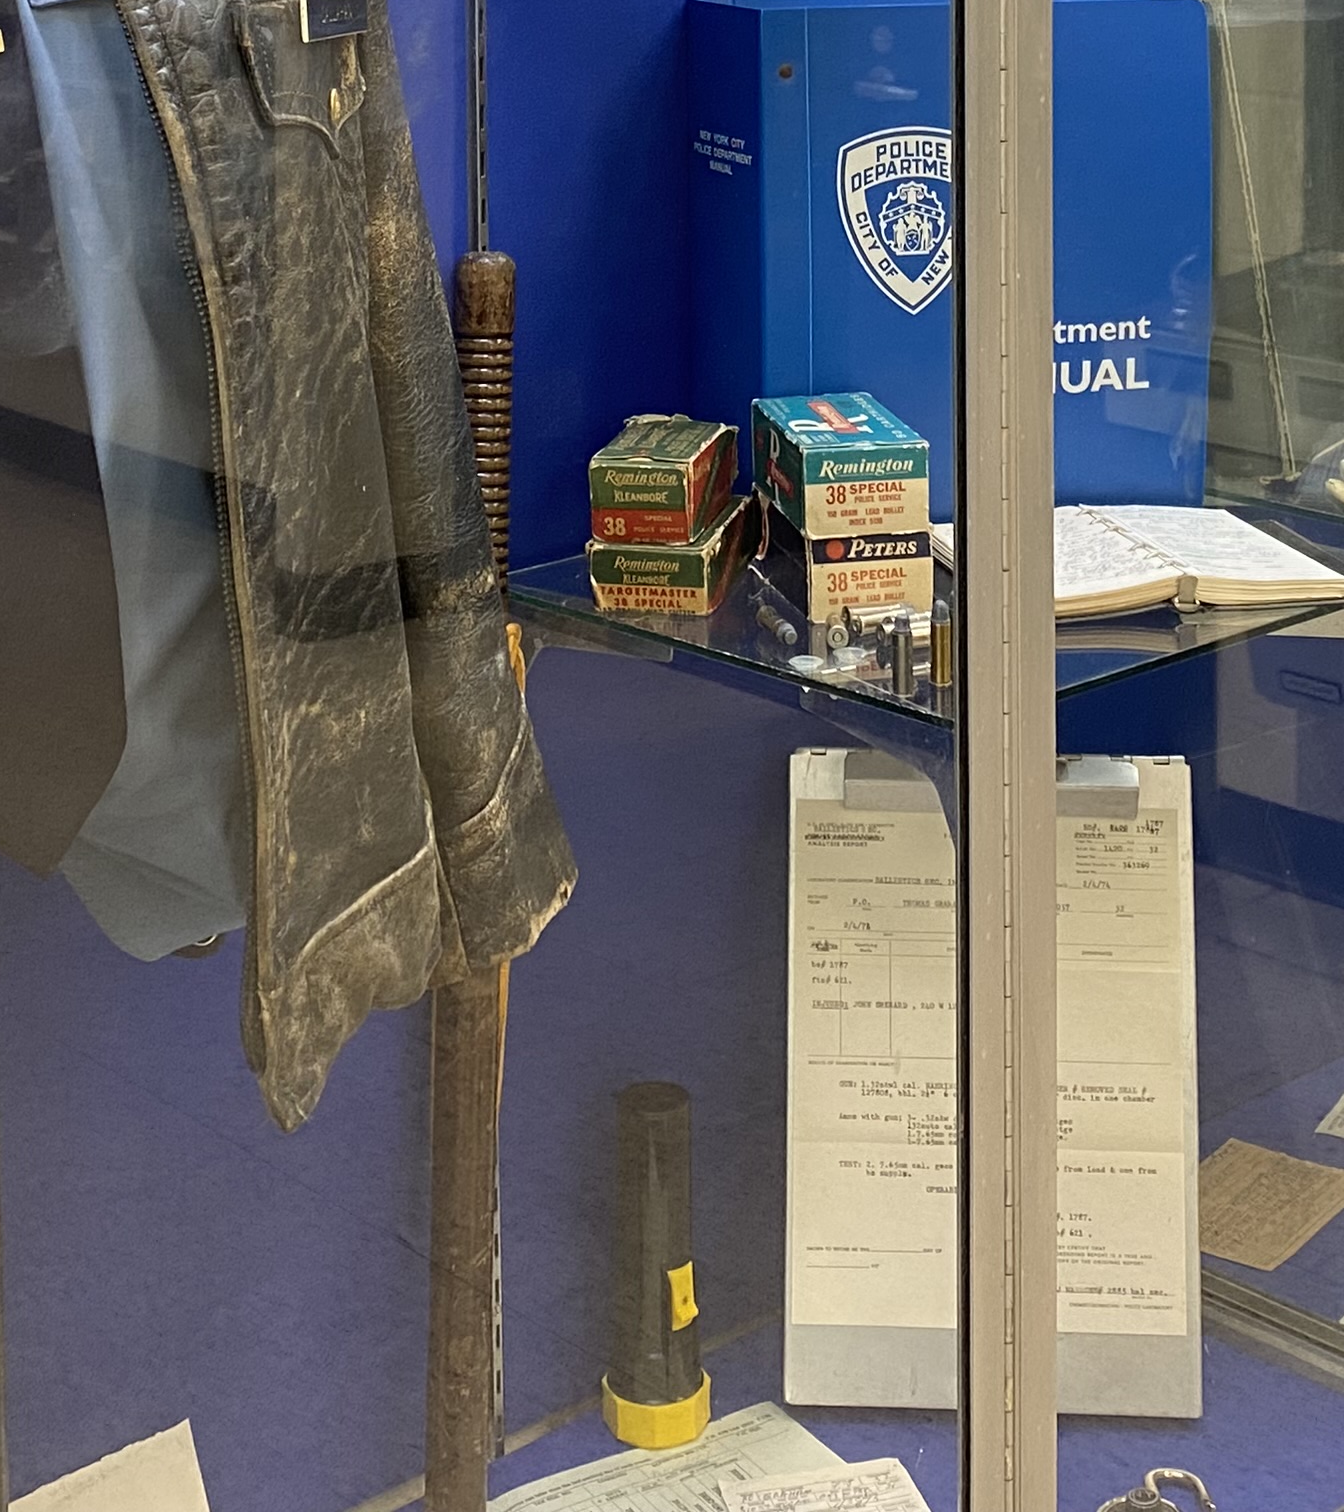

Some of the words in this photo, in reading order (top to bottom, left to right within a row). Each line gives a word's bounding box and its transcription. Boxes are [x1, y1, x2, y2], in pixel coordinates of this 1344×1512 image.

[694, 142, 712, 155] POLICE
[731, 137, 745, 150] CITY
[876, 141, 947, 162] POLICE
[851, 158, 949, 193] DEPARTME
[855, 211, 881, 252] CITY
[877, 258, 899, 279] OF
[921, 249, 950, 286] NEW
[1053, 357, 1149, 394] UAL
[604, 469, 679, 487] Remington
[819, 458, 914, 480] Remington
[613, 489, 669, 505] KLEANBORE
[825, 485, 846, 505] 38
[849, 481, 906, 495] SPECIAL
[878, 494, 902, 502] SERVICE
[604, 517, 626, 536] 38
[847, 538, 917, 559] PETERS
[613, 555, 680, 572] Remington
[827, 573, 848, 593] 38
[851, 568, 907, 582] SPECIAL
[613, 598, 628, 607] 38
[634, 598, 682, 609] SPECIAL
